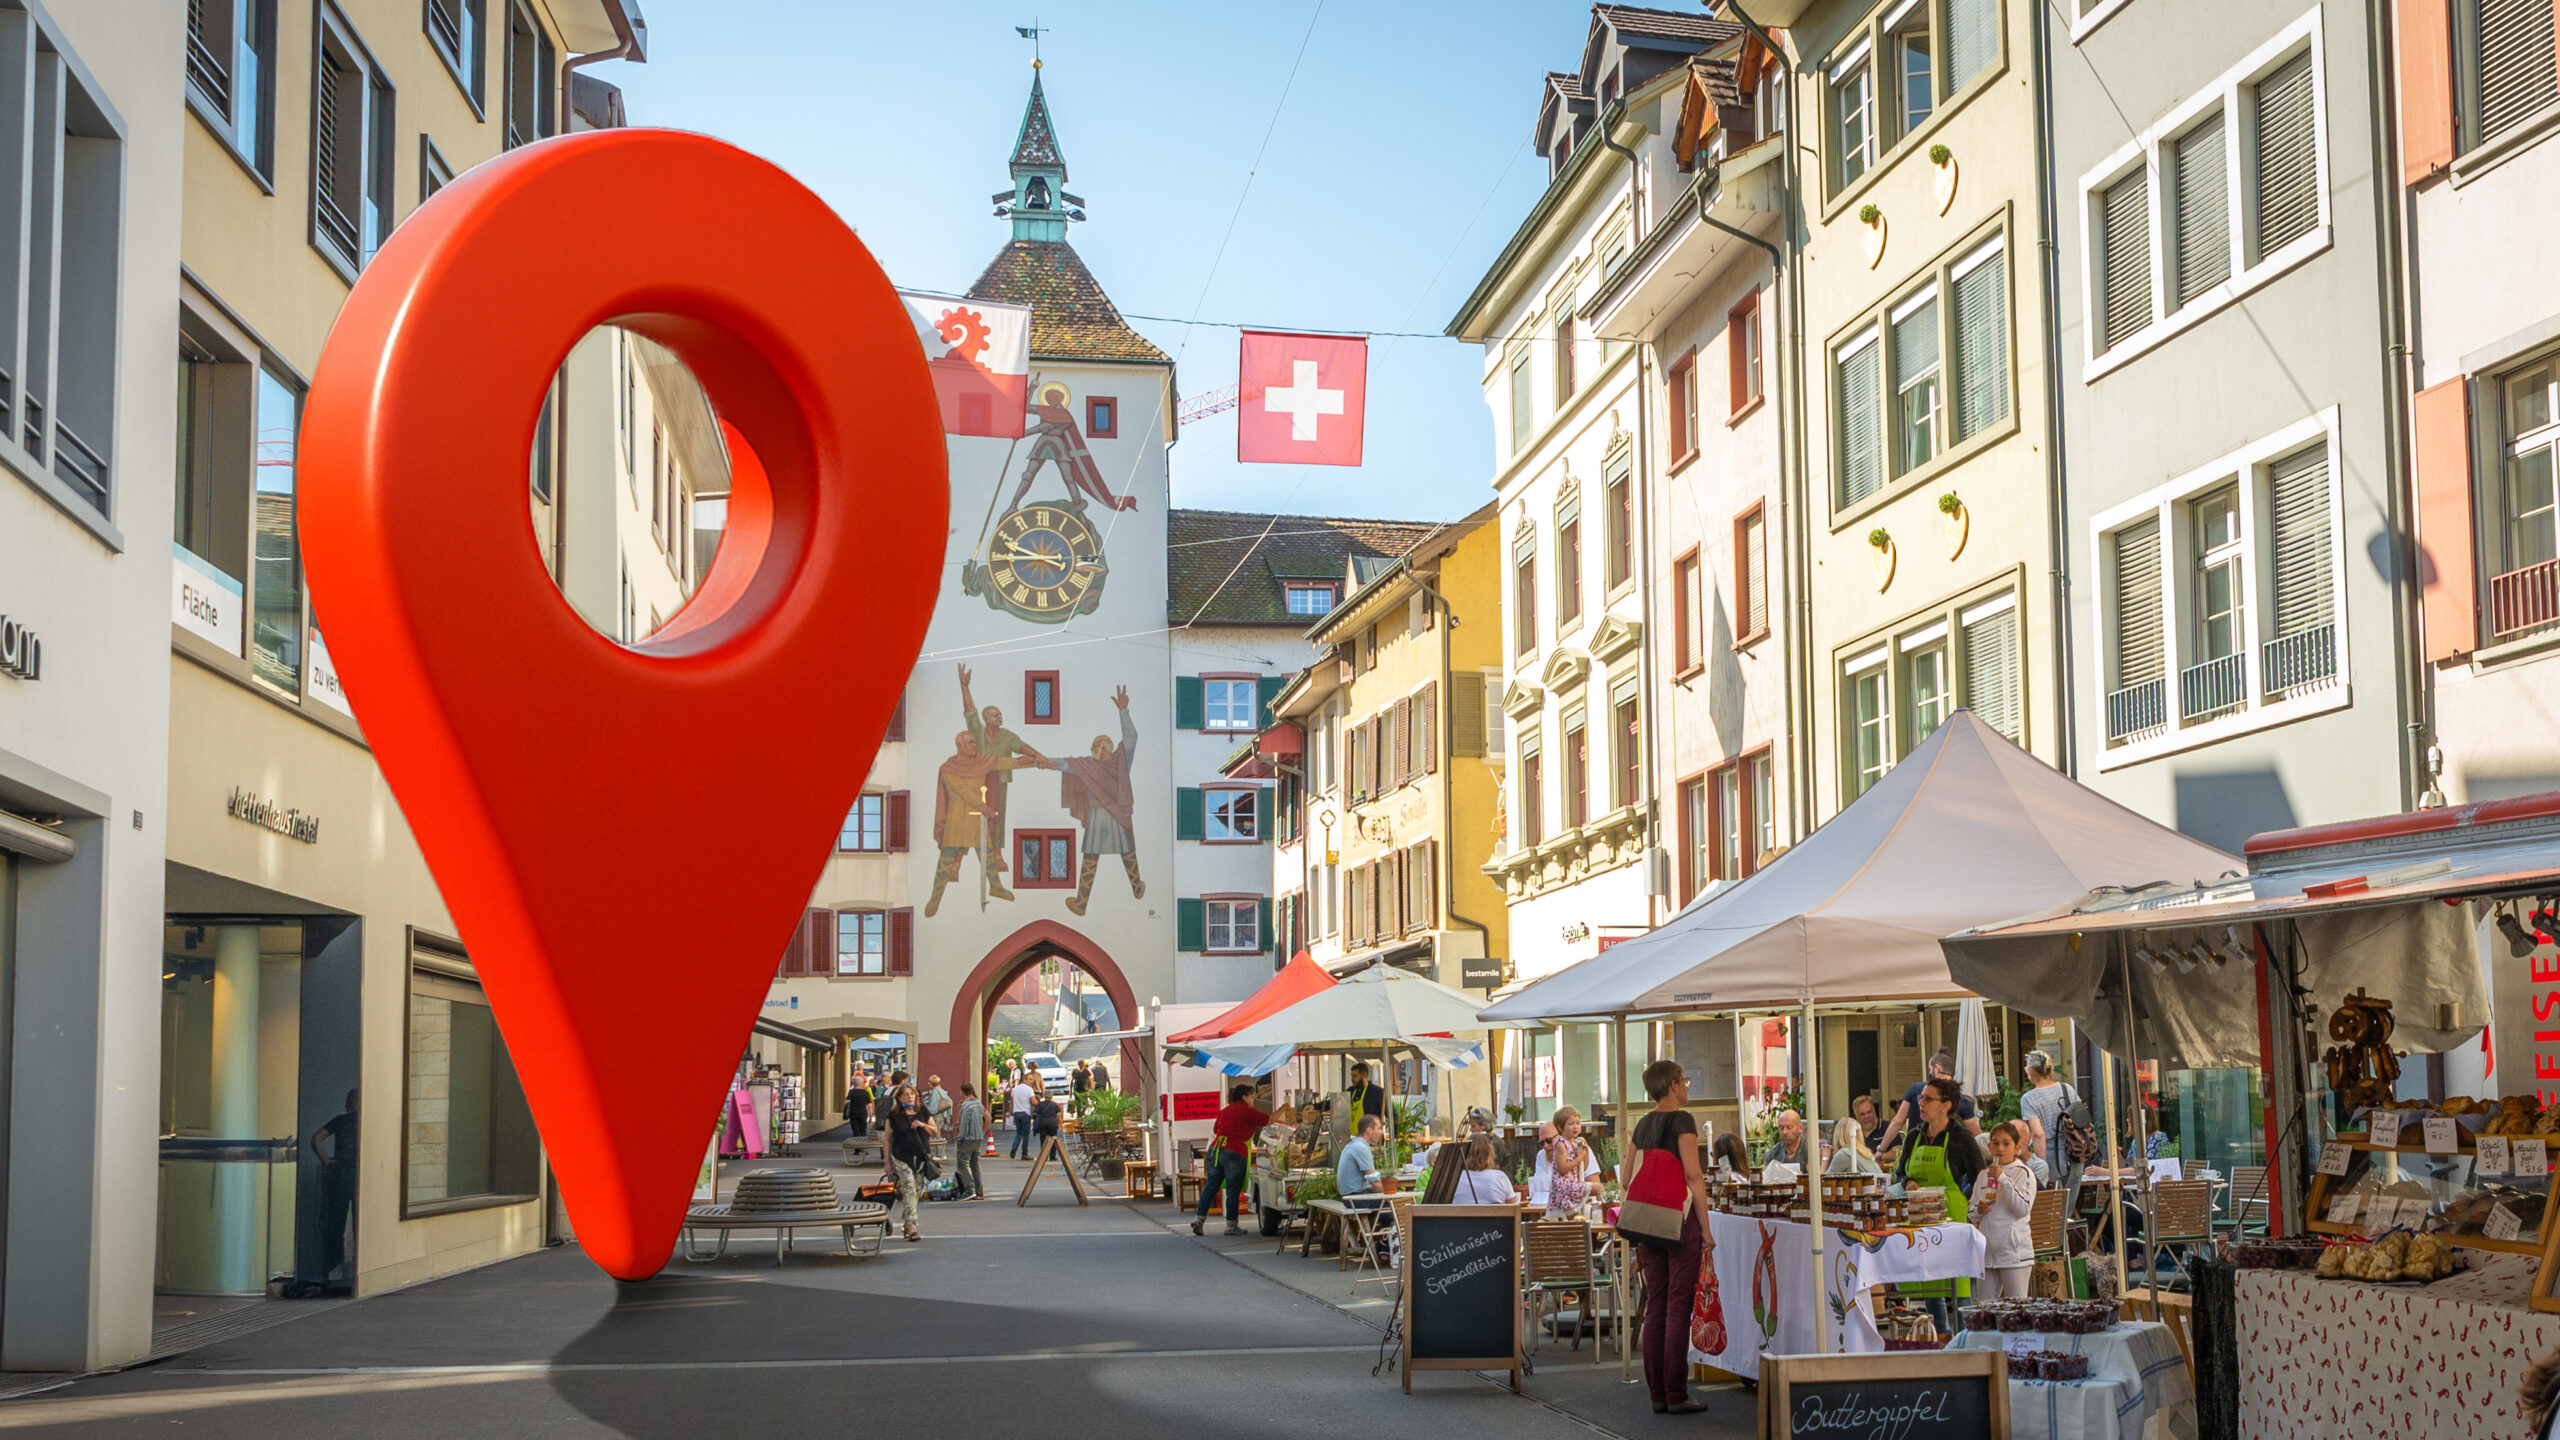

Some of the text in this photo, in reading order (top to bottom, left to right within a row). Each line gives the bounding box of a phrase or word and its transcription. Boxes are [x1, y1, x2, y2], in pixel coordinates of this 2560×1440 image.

[183, 584, 218, 627] Fläche
[0, 614, 41, 681] ann
[314, 666, 324, 686] zu
[1466, 969, 1500, 977] bestsmile
[1419, 1230, 1502, 1269] Sizilianische
[1426, 1254, 1507, 1295] Spezialitäten
[1791, 1390, 1950, 1440] Buttergipfel
